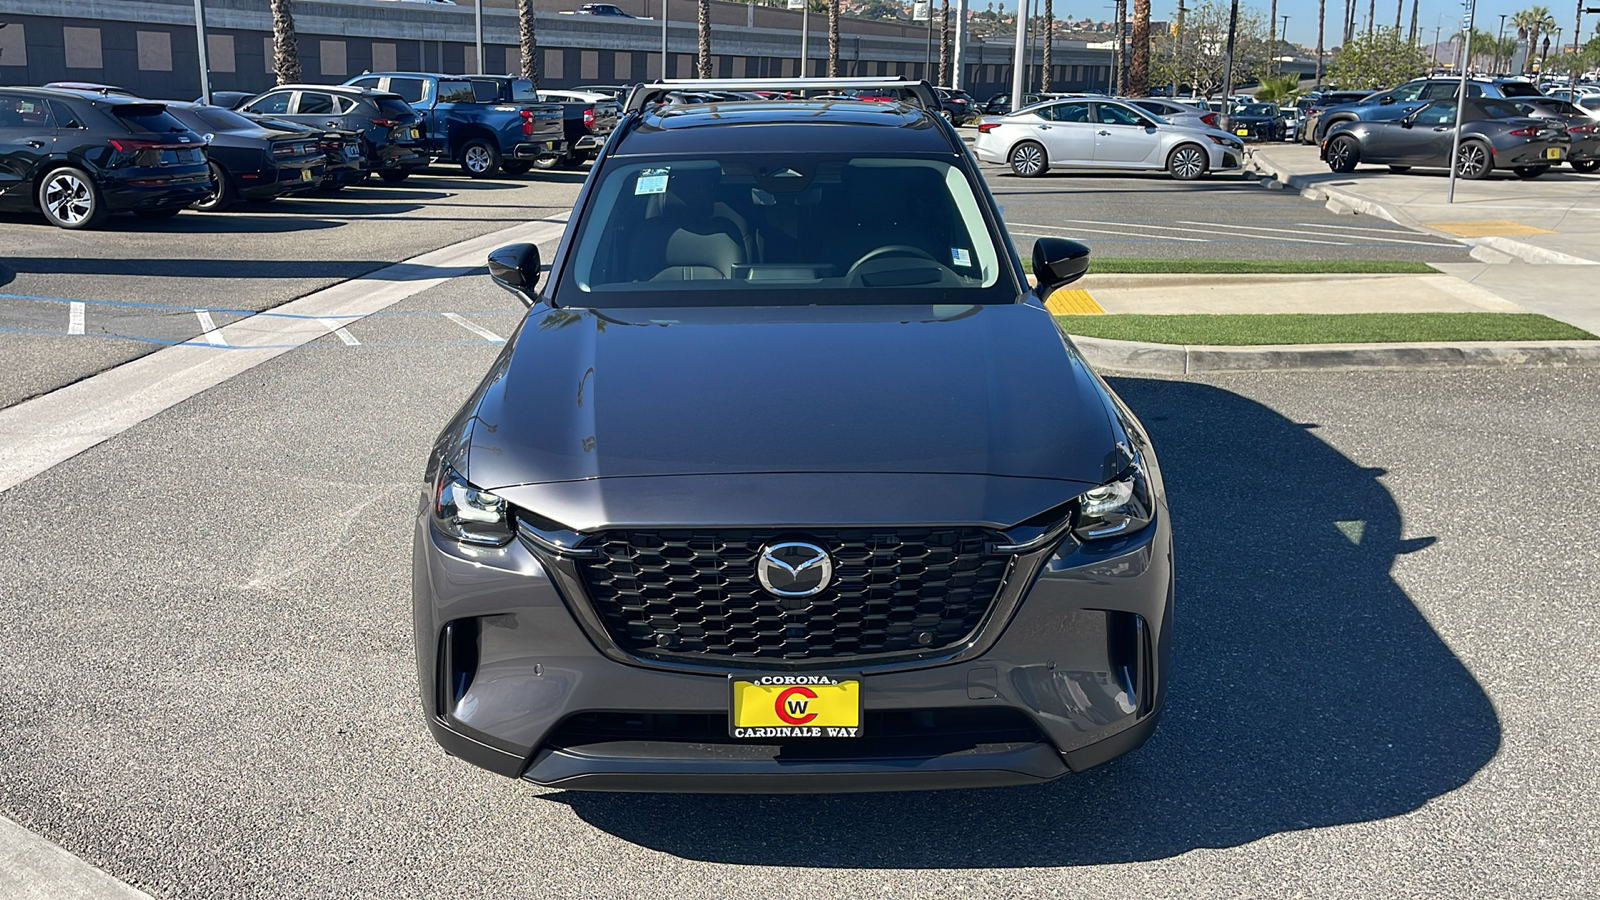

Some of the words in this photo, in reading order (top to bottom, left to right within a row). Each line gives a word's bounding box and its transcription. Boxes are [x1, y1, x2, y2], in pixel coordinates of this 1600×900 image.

[761, 676, 830, 685] CORONA
[735, 727, 821, 737] CARDINALE
[827, 728, 858, 737] WAY
